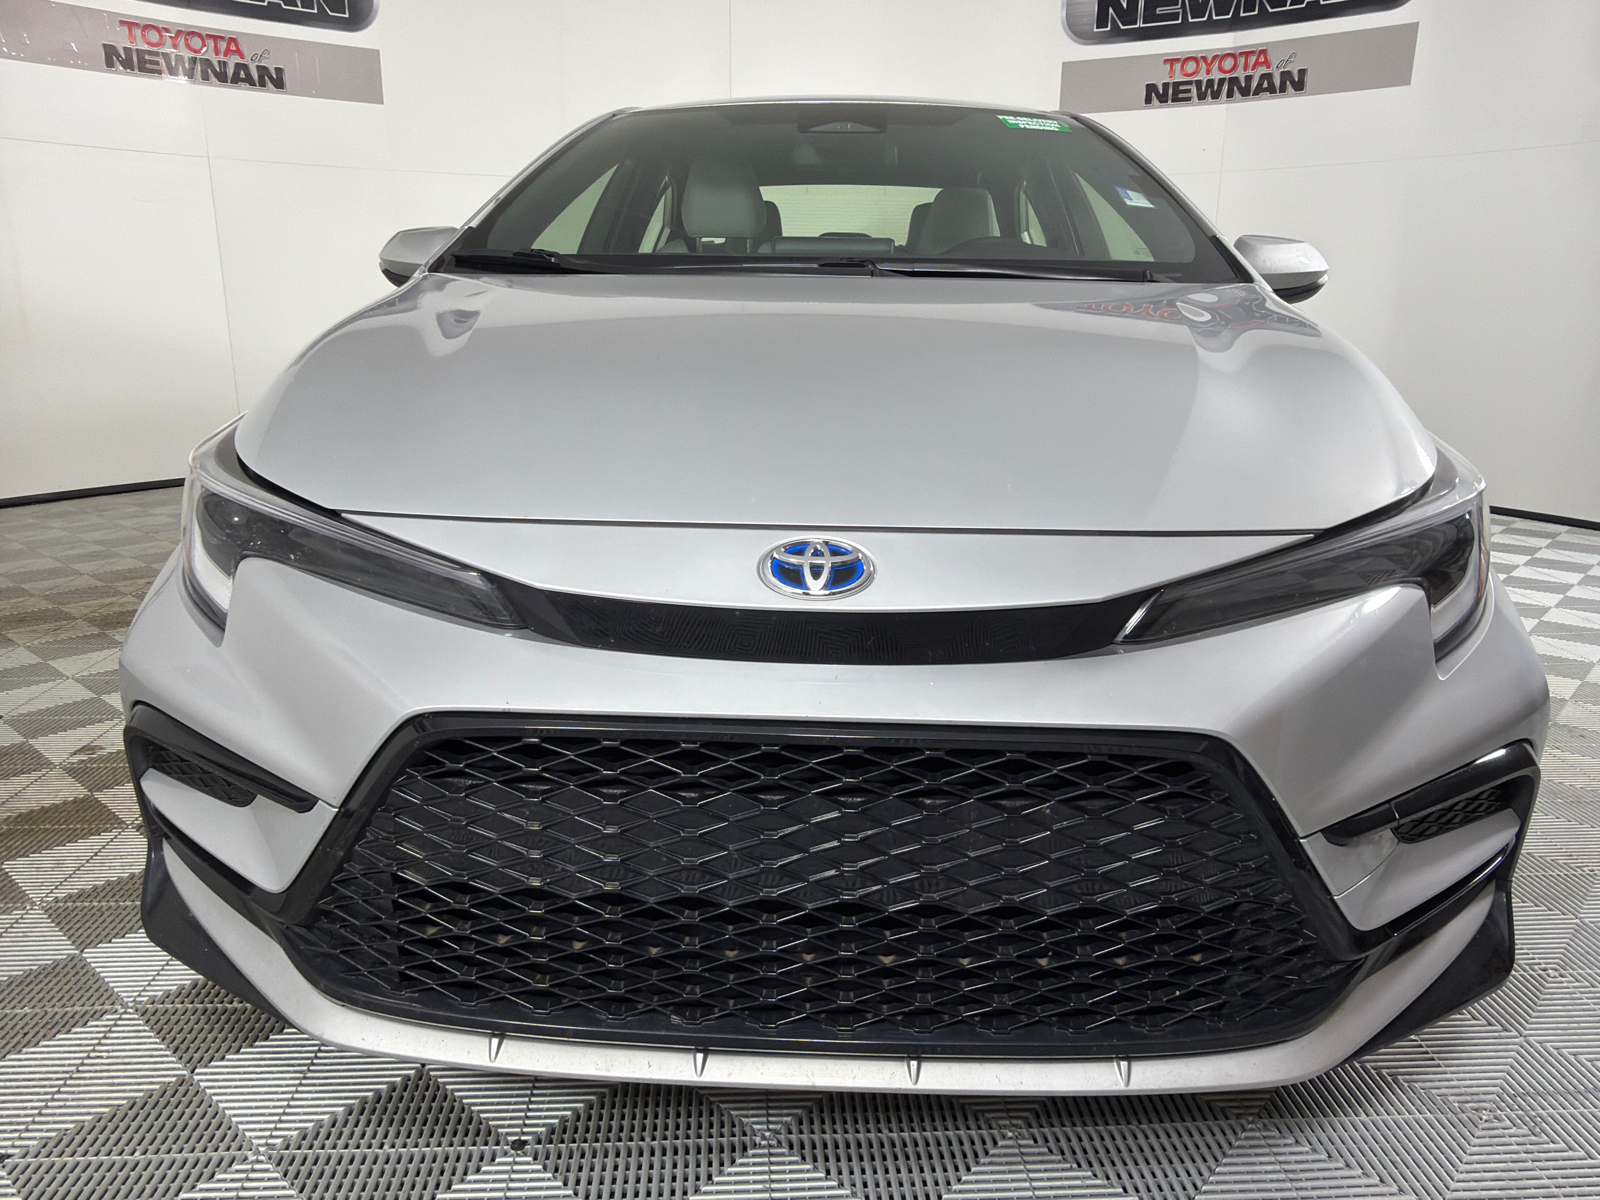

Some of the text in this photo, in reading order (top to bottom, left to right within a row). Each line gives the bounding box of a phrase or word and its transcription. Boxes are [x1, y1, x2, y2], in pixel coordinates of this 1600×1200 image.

[119, 19, 270, 63] TOYOTA of
[102, 43, 286, 91] NEWNAN
[1163, 48, 1297, 79] TOYOTA of
[1144, 68, 1308, 105] NEWNAN
